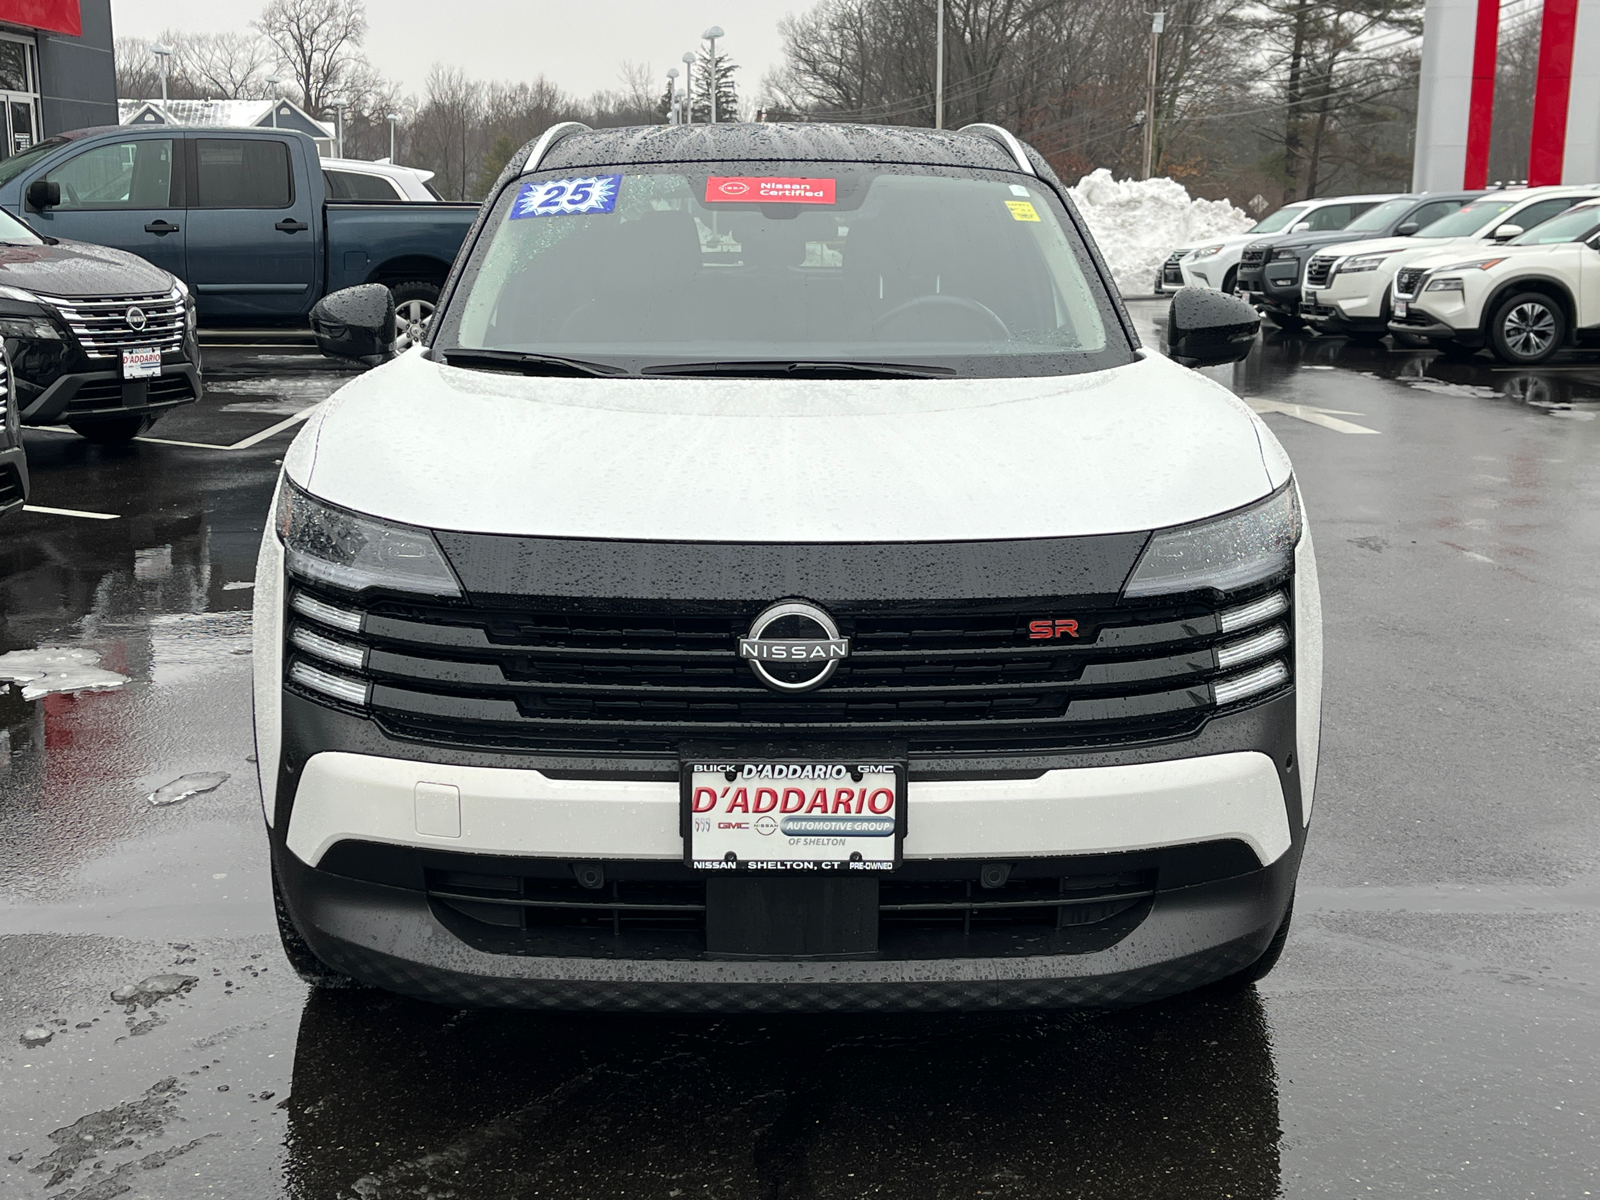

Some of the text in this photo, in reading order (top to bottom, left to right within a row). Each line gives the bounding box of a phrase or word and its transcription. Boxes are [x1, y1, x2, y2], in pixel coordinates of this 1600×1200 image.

[760, 182, 810, 190] Nissan
[537, 183, 594, 208] 25
[760, 189, 824, 197] Certified
[123, 354, 160, 364] D'ADDARIO
[1029, 619, 1079, 639] SR
[742, 643, 846, 659] NISSAN
[693, 764, 737, 772] BUICK
[742, 764, 847, 780] D'ADDARIO
[857, 765, 895, 773] GMC
[692, 786, 895, 815] D'ADDARIO
[718, 822, 750, 830] GMC
[786, 821, 891, 832] AUTOMOTIVE GROUP
[788, 838, 847, 847] OF SHELTON
[693, 861, 737, 870] NISSAN
[747, 861, 841, 871] SHELTON, CT
[849, 861, 893, 871] PRE-OWNED
